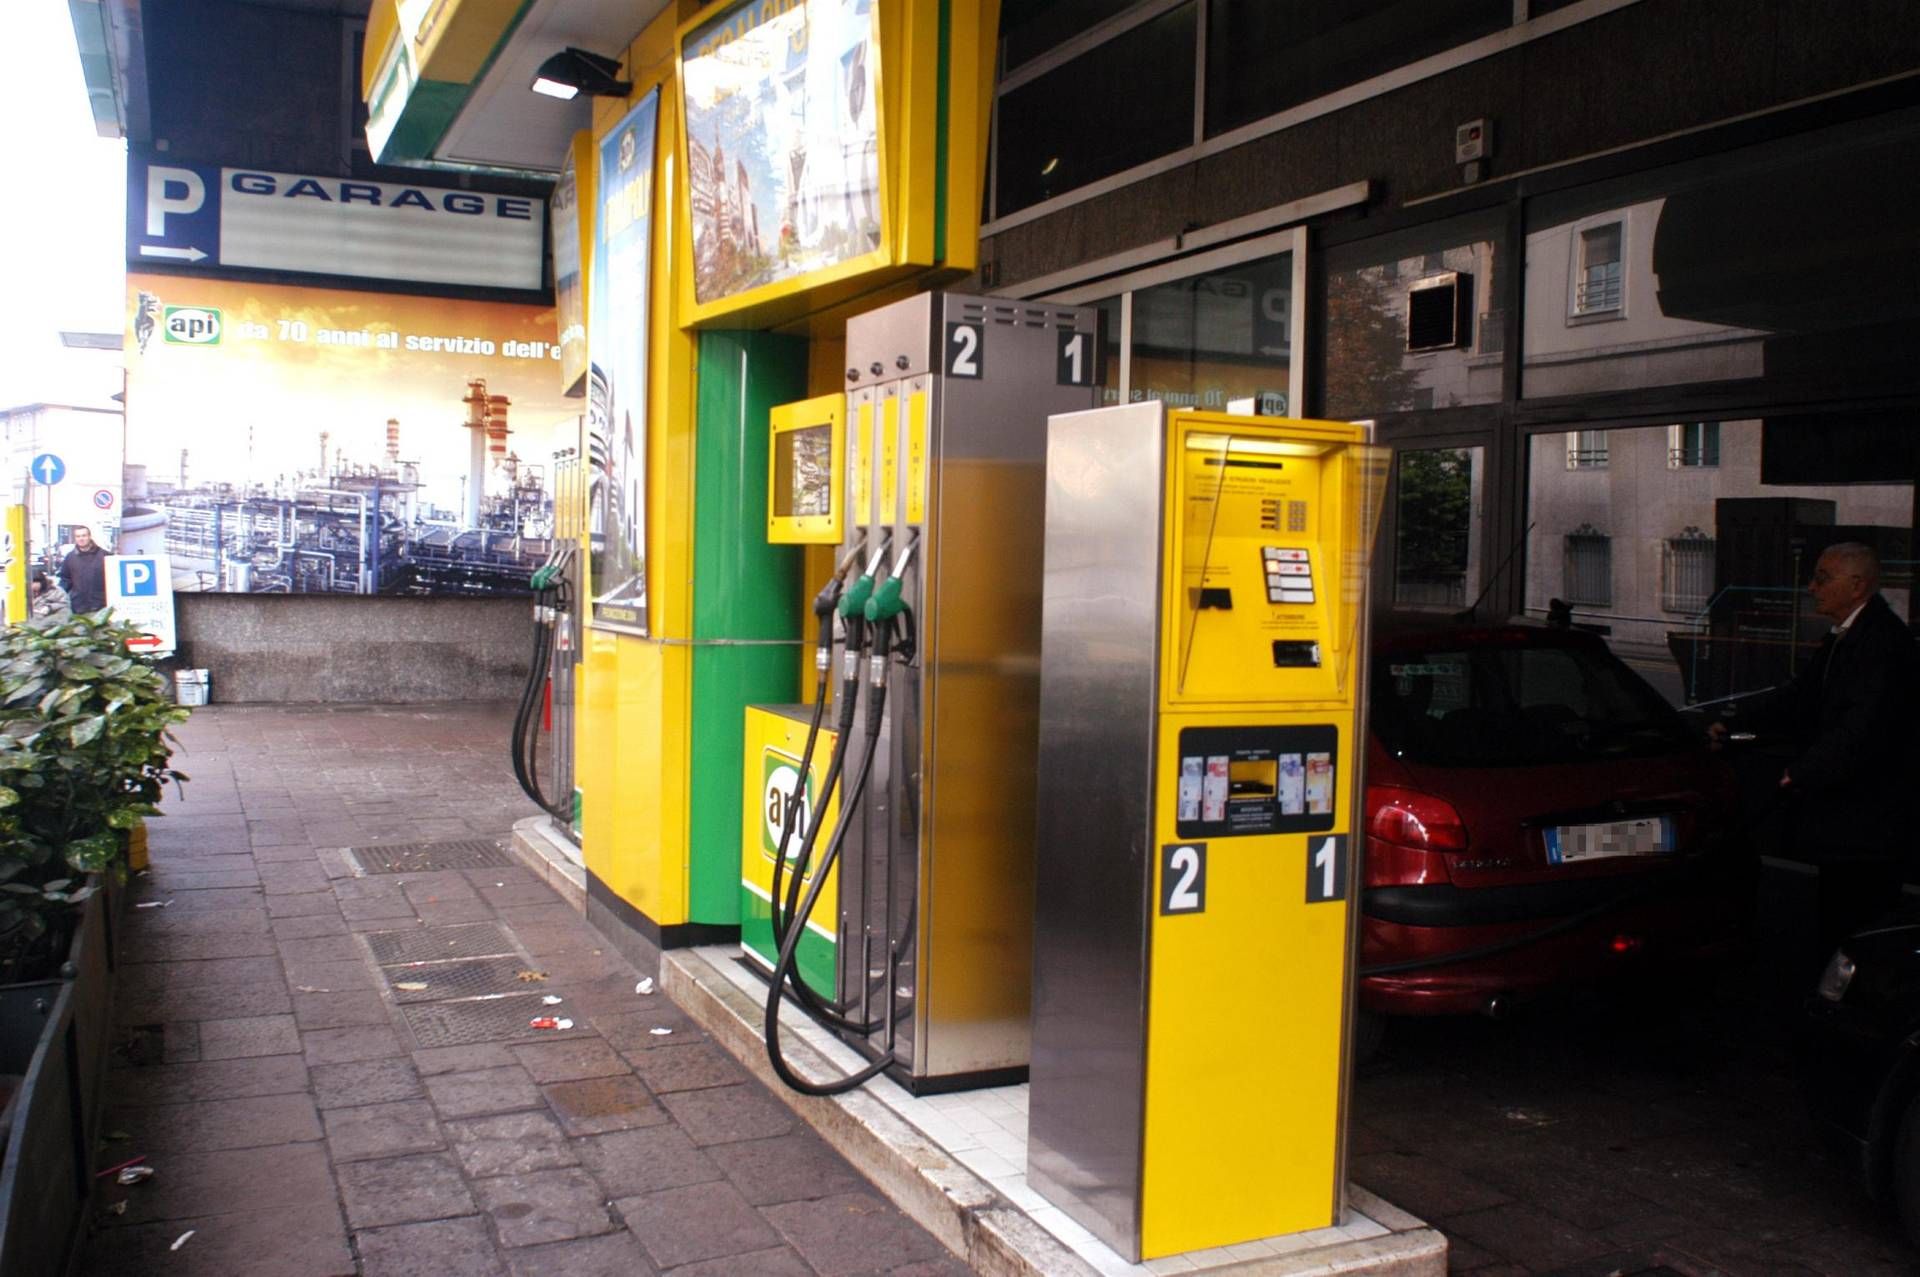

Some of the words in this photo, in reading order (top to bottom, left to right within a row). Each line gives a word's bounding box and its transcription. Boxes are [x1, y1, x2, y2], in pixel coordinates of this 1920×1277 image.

[146, 165, 206, 237] P
[230, 172, 532, 221] GARAGE
[170, 313, 214, 338] api
[277, 319, 308, 343] 70
[316, 328, 369, 347] anni
[376, 330, 399, 350] al
[405, 333, 496, 356] servizio
[951, 325, 978, 376] 2
[1064, 333, 1083, 384] 1
[125, 562, 151, 594] P
[1168, 846, 1200, 911] 2
[1314, 836, 1336, 898] 1
